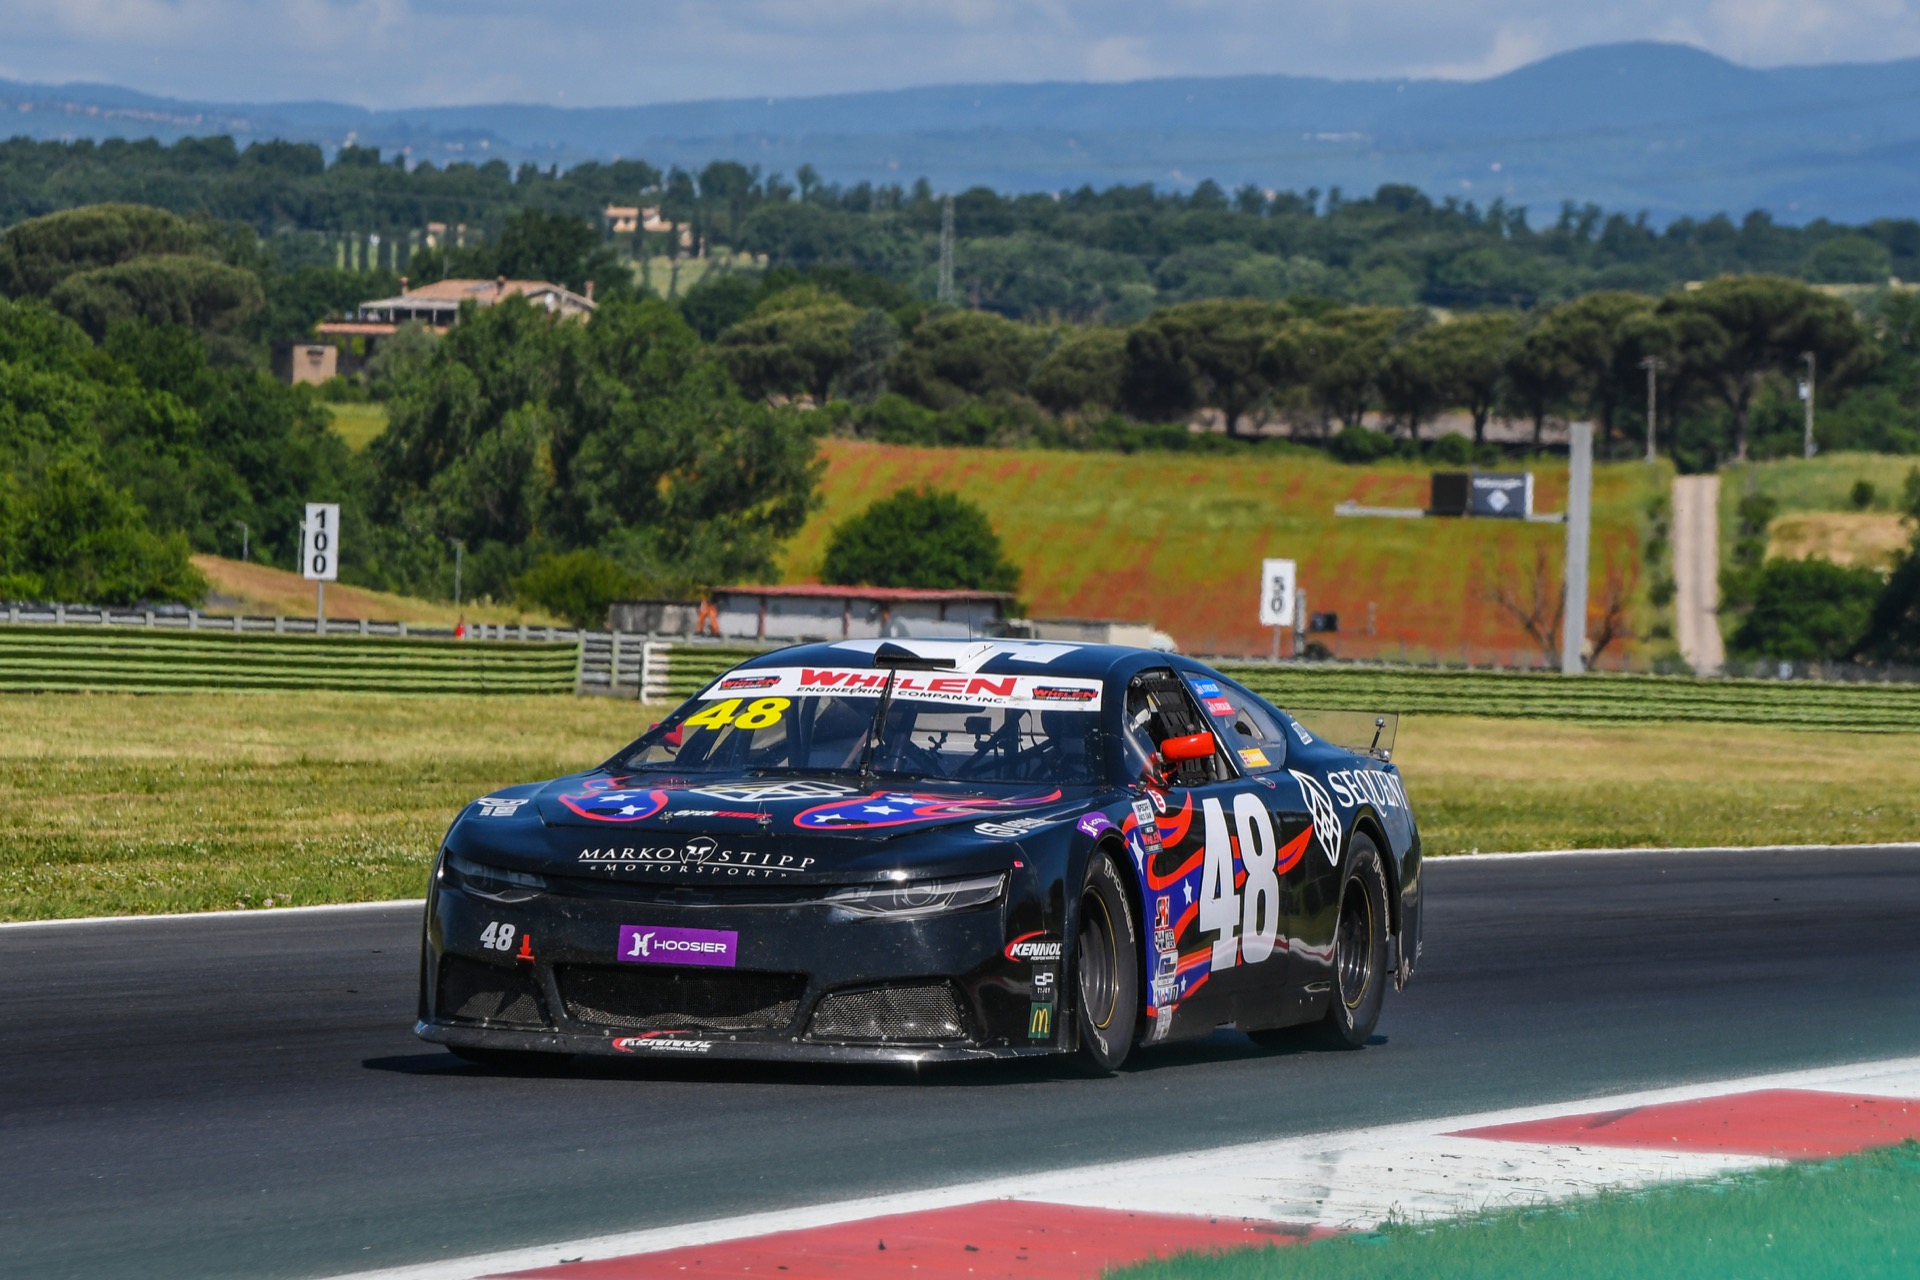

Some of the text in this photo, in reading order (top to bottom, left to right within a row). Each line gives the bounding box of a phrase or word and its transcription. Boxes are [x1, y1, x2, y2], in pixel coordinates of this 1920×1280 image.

[312, 508, 328, 575] 100
[1271, 576, 1285, 613] 50
[720, 678, 782, 688] WHELEN
[800, 668, 1018, 697] WHELEN
[1033, 688, 1098, 698] WHELEN
[797, 687, 1007, 704] ENGINEERIN COMPANY INC.
[684, 697, 792, 731] 48
[1327, 769, 1409, 818] SEQUENT
[578, 847, 816, 869] MARKO STIPP
[603, 863, 774, 878] MOTORSPORT
[1199, 792, 1280, 973] 48
[1110, 871, 1135, 944] HOOSIER
[480, 921, 516, 951] 48
[653, 940, 727, 953] HOOSIER
[1010, 943, 1063, 957] KENNOL
[619, 1038, 712, 1047] KENNOL
